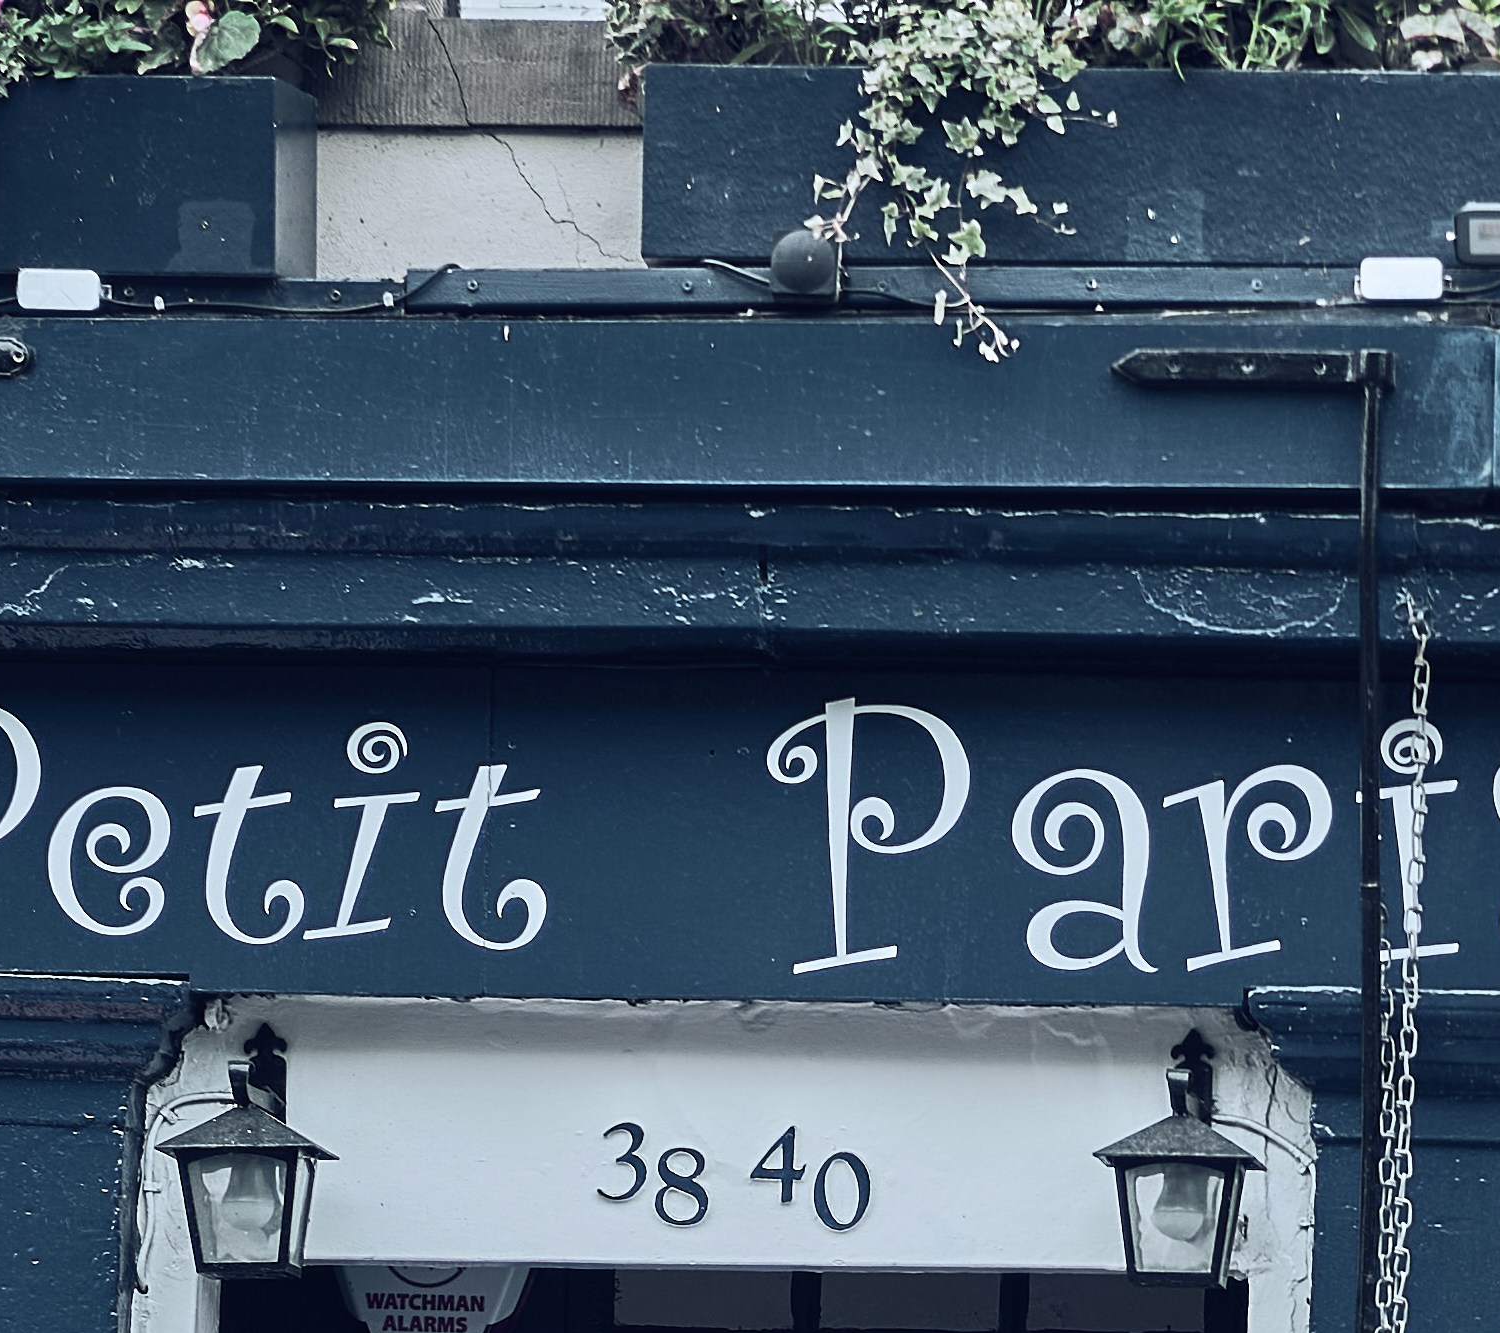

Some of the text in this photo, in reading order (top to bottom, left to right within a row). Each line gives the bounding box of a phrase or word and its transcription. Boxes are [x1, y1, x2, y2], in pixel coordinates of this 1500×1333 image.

[596, 1121, 871, 1233] 38 40
[365, 1291, 486, 1313] WATCHMAN
[382, 1314, 468, 1333] ALARMS
